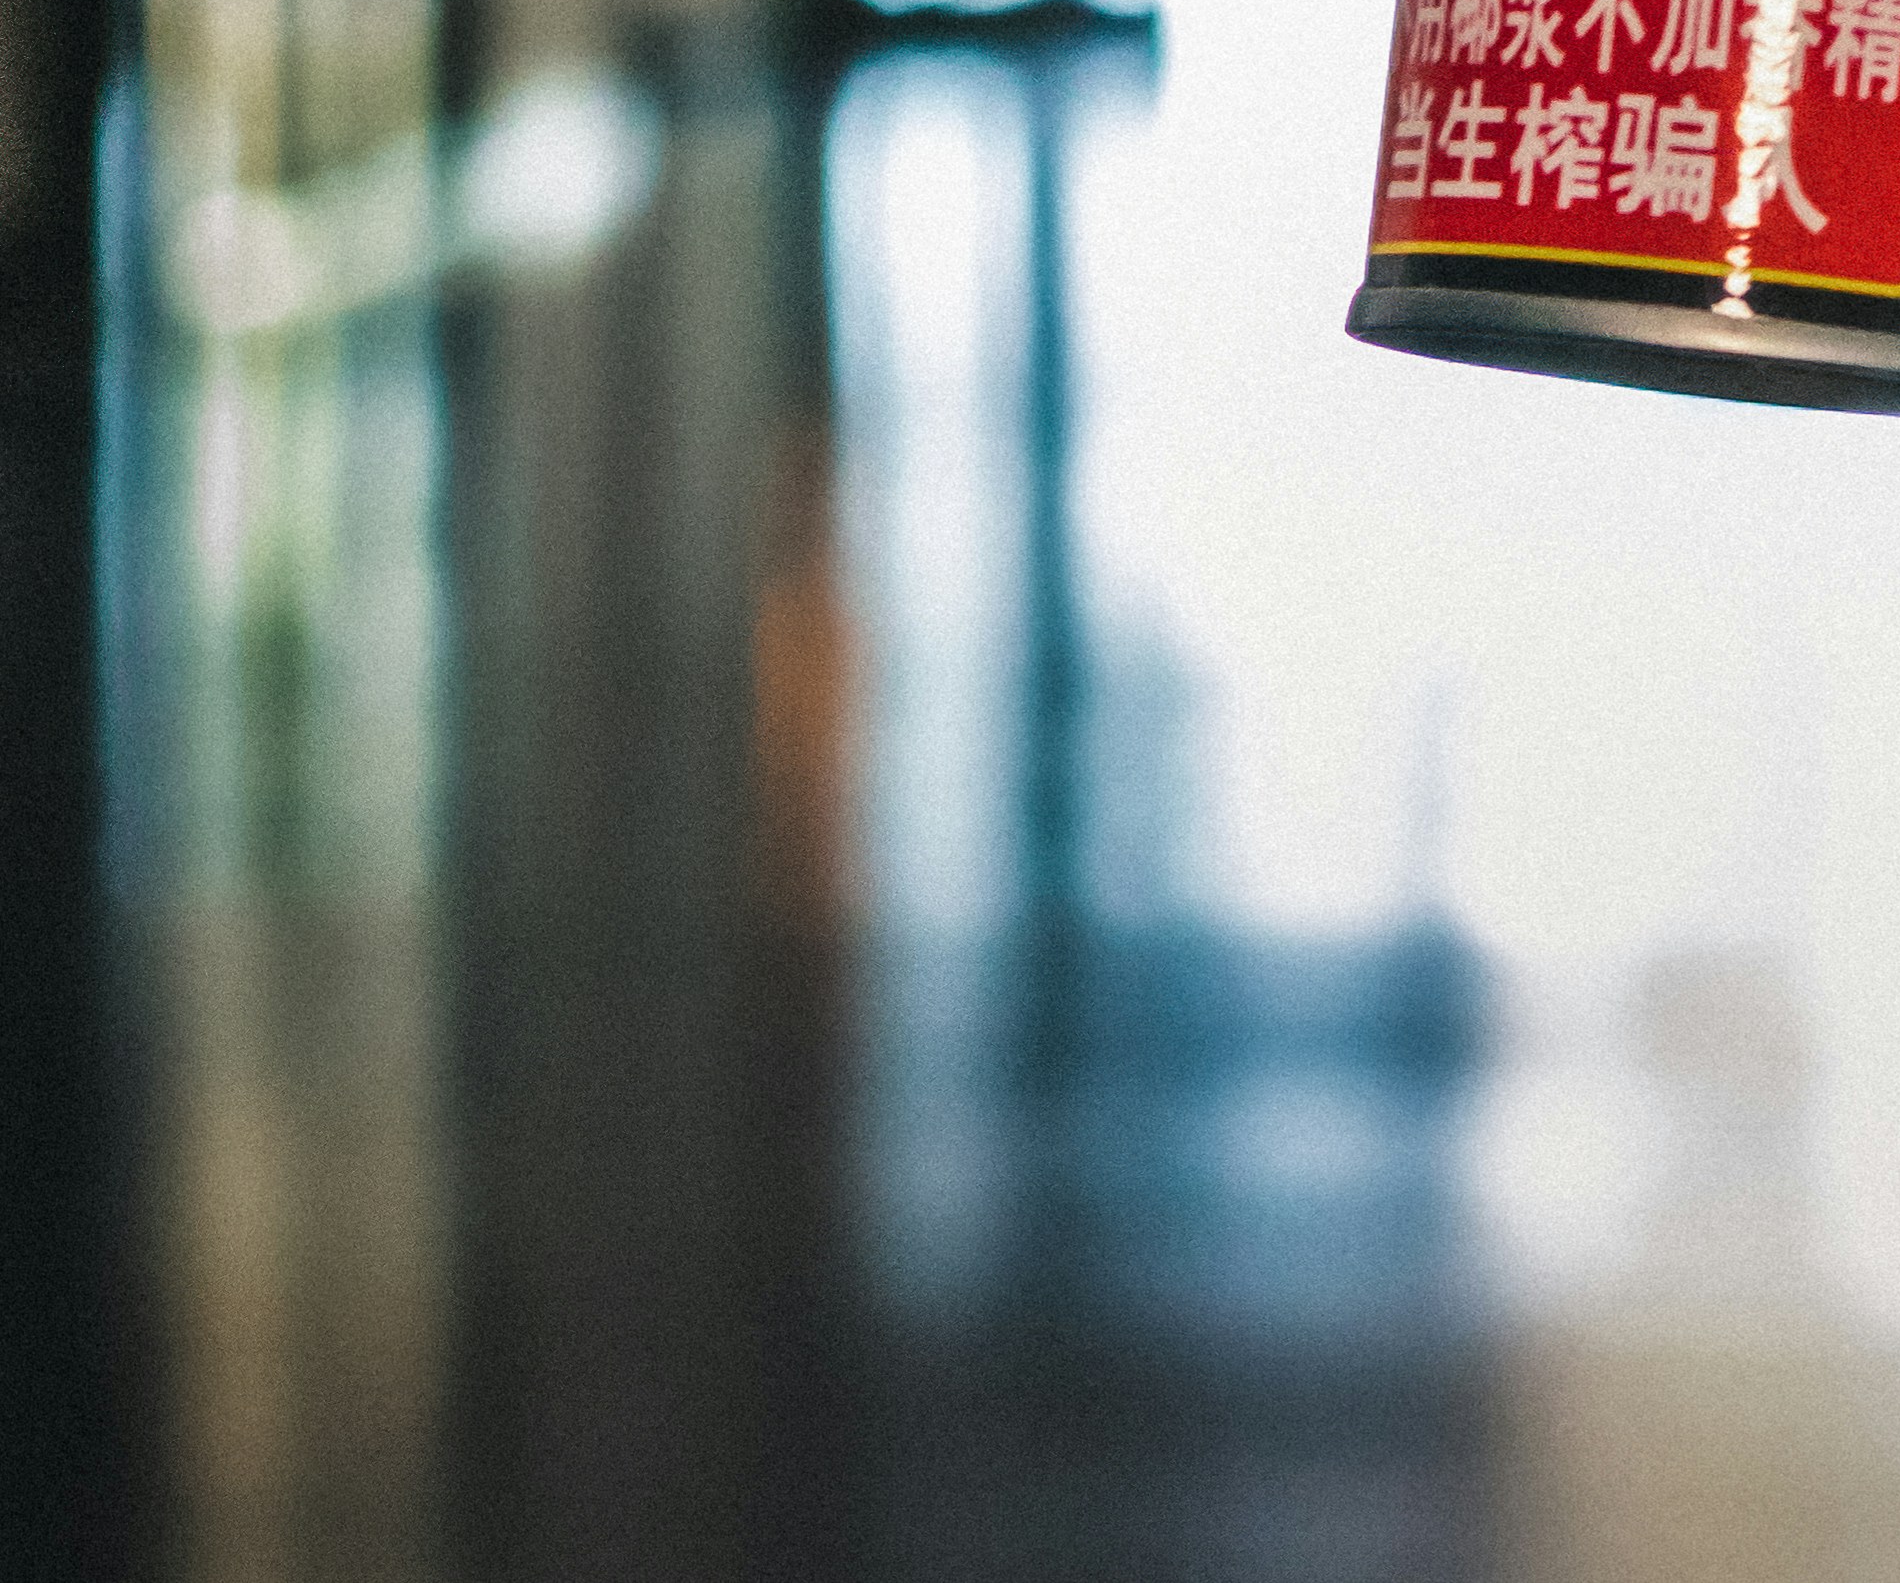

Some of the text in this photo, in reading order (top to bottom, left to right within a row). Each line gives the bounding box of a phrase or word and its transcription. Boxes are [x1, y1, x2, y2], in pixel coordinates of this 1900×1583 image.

[1386, 78, 1829, 234] 当生榨骗人
